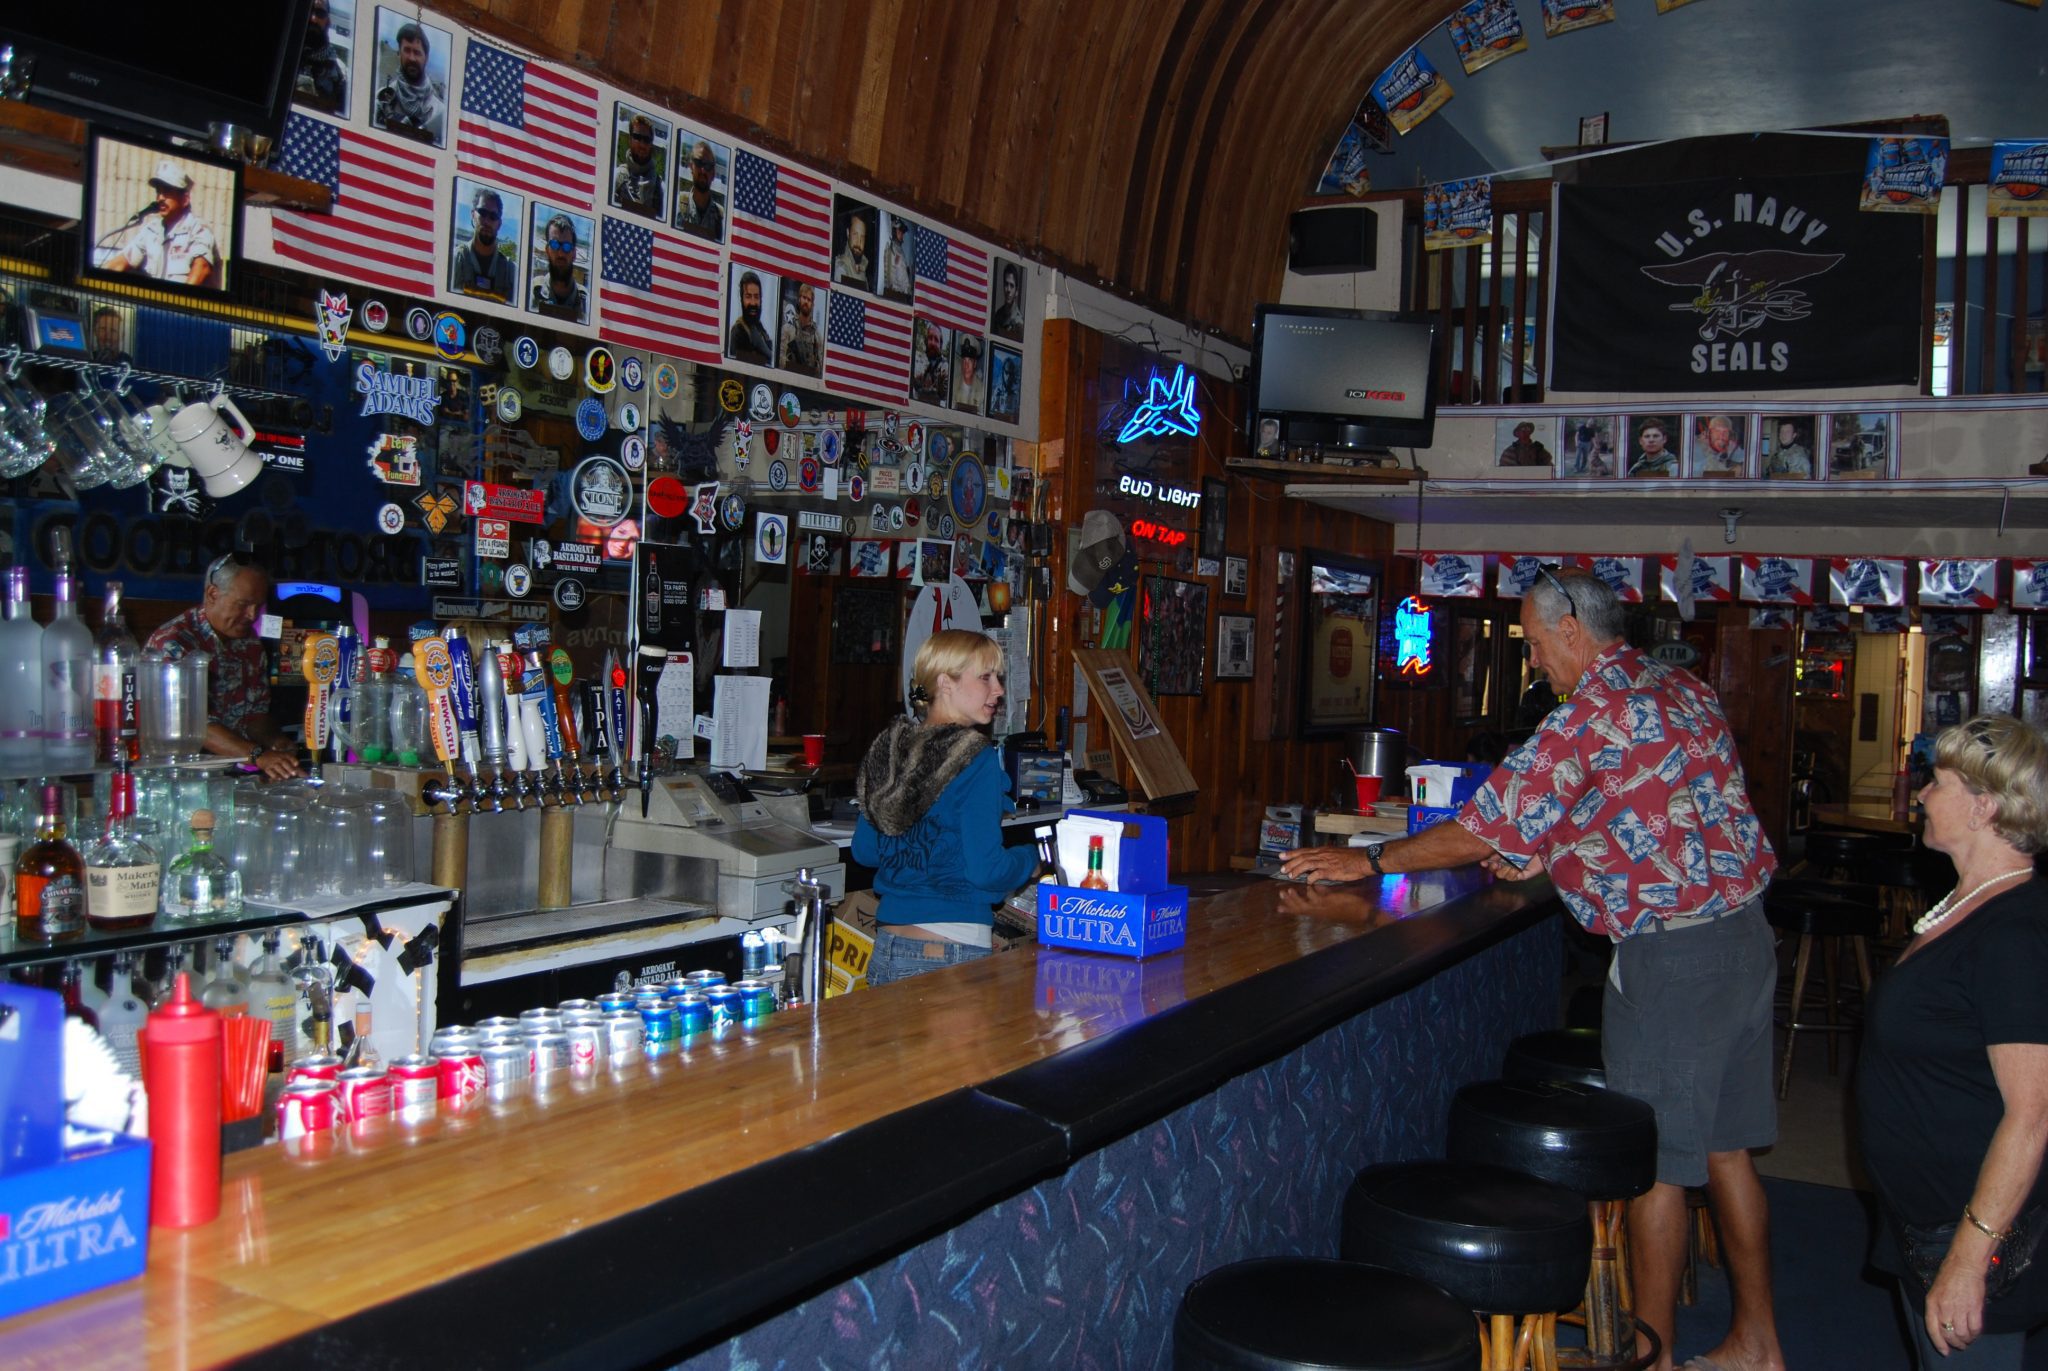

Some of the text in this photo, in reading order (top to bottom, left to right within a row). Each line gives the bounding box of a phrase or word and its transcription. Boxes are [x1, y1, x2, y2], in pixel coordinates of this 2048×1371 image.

[69, 71, 100, 87] SONY
[1383, 63, 1417, 98] MARCH
[1884, 170, 1927, 183] MARCH
[1655, 193, 1828, 258] U.S. NAVY
[1691, 341, 1789, 374] SEALS
[356, 363, 441, 406] SAMUEL
[360, 391, 434, 426] ADAMS
[278, 455, 304, 467] ONE
[581, 490, 623, 514] STONE
[1120, 475, 1201, 509] BUD LIGHT
[1132, 519, 1187, 546] ON TAP
[553, 551, 602, 565] BASTARD ALE
[561, 542, 596, 554] ARROGANT
[561, 593, 581, 605] STONE
[512, 605, 548, 621] HARP
[1659, 646, 1687, 660] ATM
[464, 651, 474, 691] LIGHT
[125, 674, 135, 721] TUACA
[318, 689, 328, 745] NEWCASTLE
[440, 694, 456, 756] NEWCASTLE
[596, 692, 608, 748] IPA
[1268, 834, 1291, 845] LIGHT
[117, 869, 159, 881] Maker's
[130, 878, 158, 890] Mark
[41, 887, 68, 900] CHIVAS
[1061, 896, 1128, 919] Michelob
[1154, 905, 1182, 922] Michelob
[1044, 914, 1137, 948] ULTRA
[1148, 918, 1184, 940] ULTRA
[641, 960, 677, 975] ARROGANT
[666, 969, 682, 980] ALE
[16, 1187, 125, 1237] Michelob
